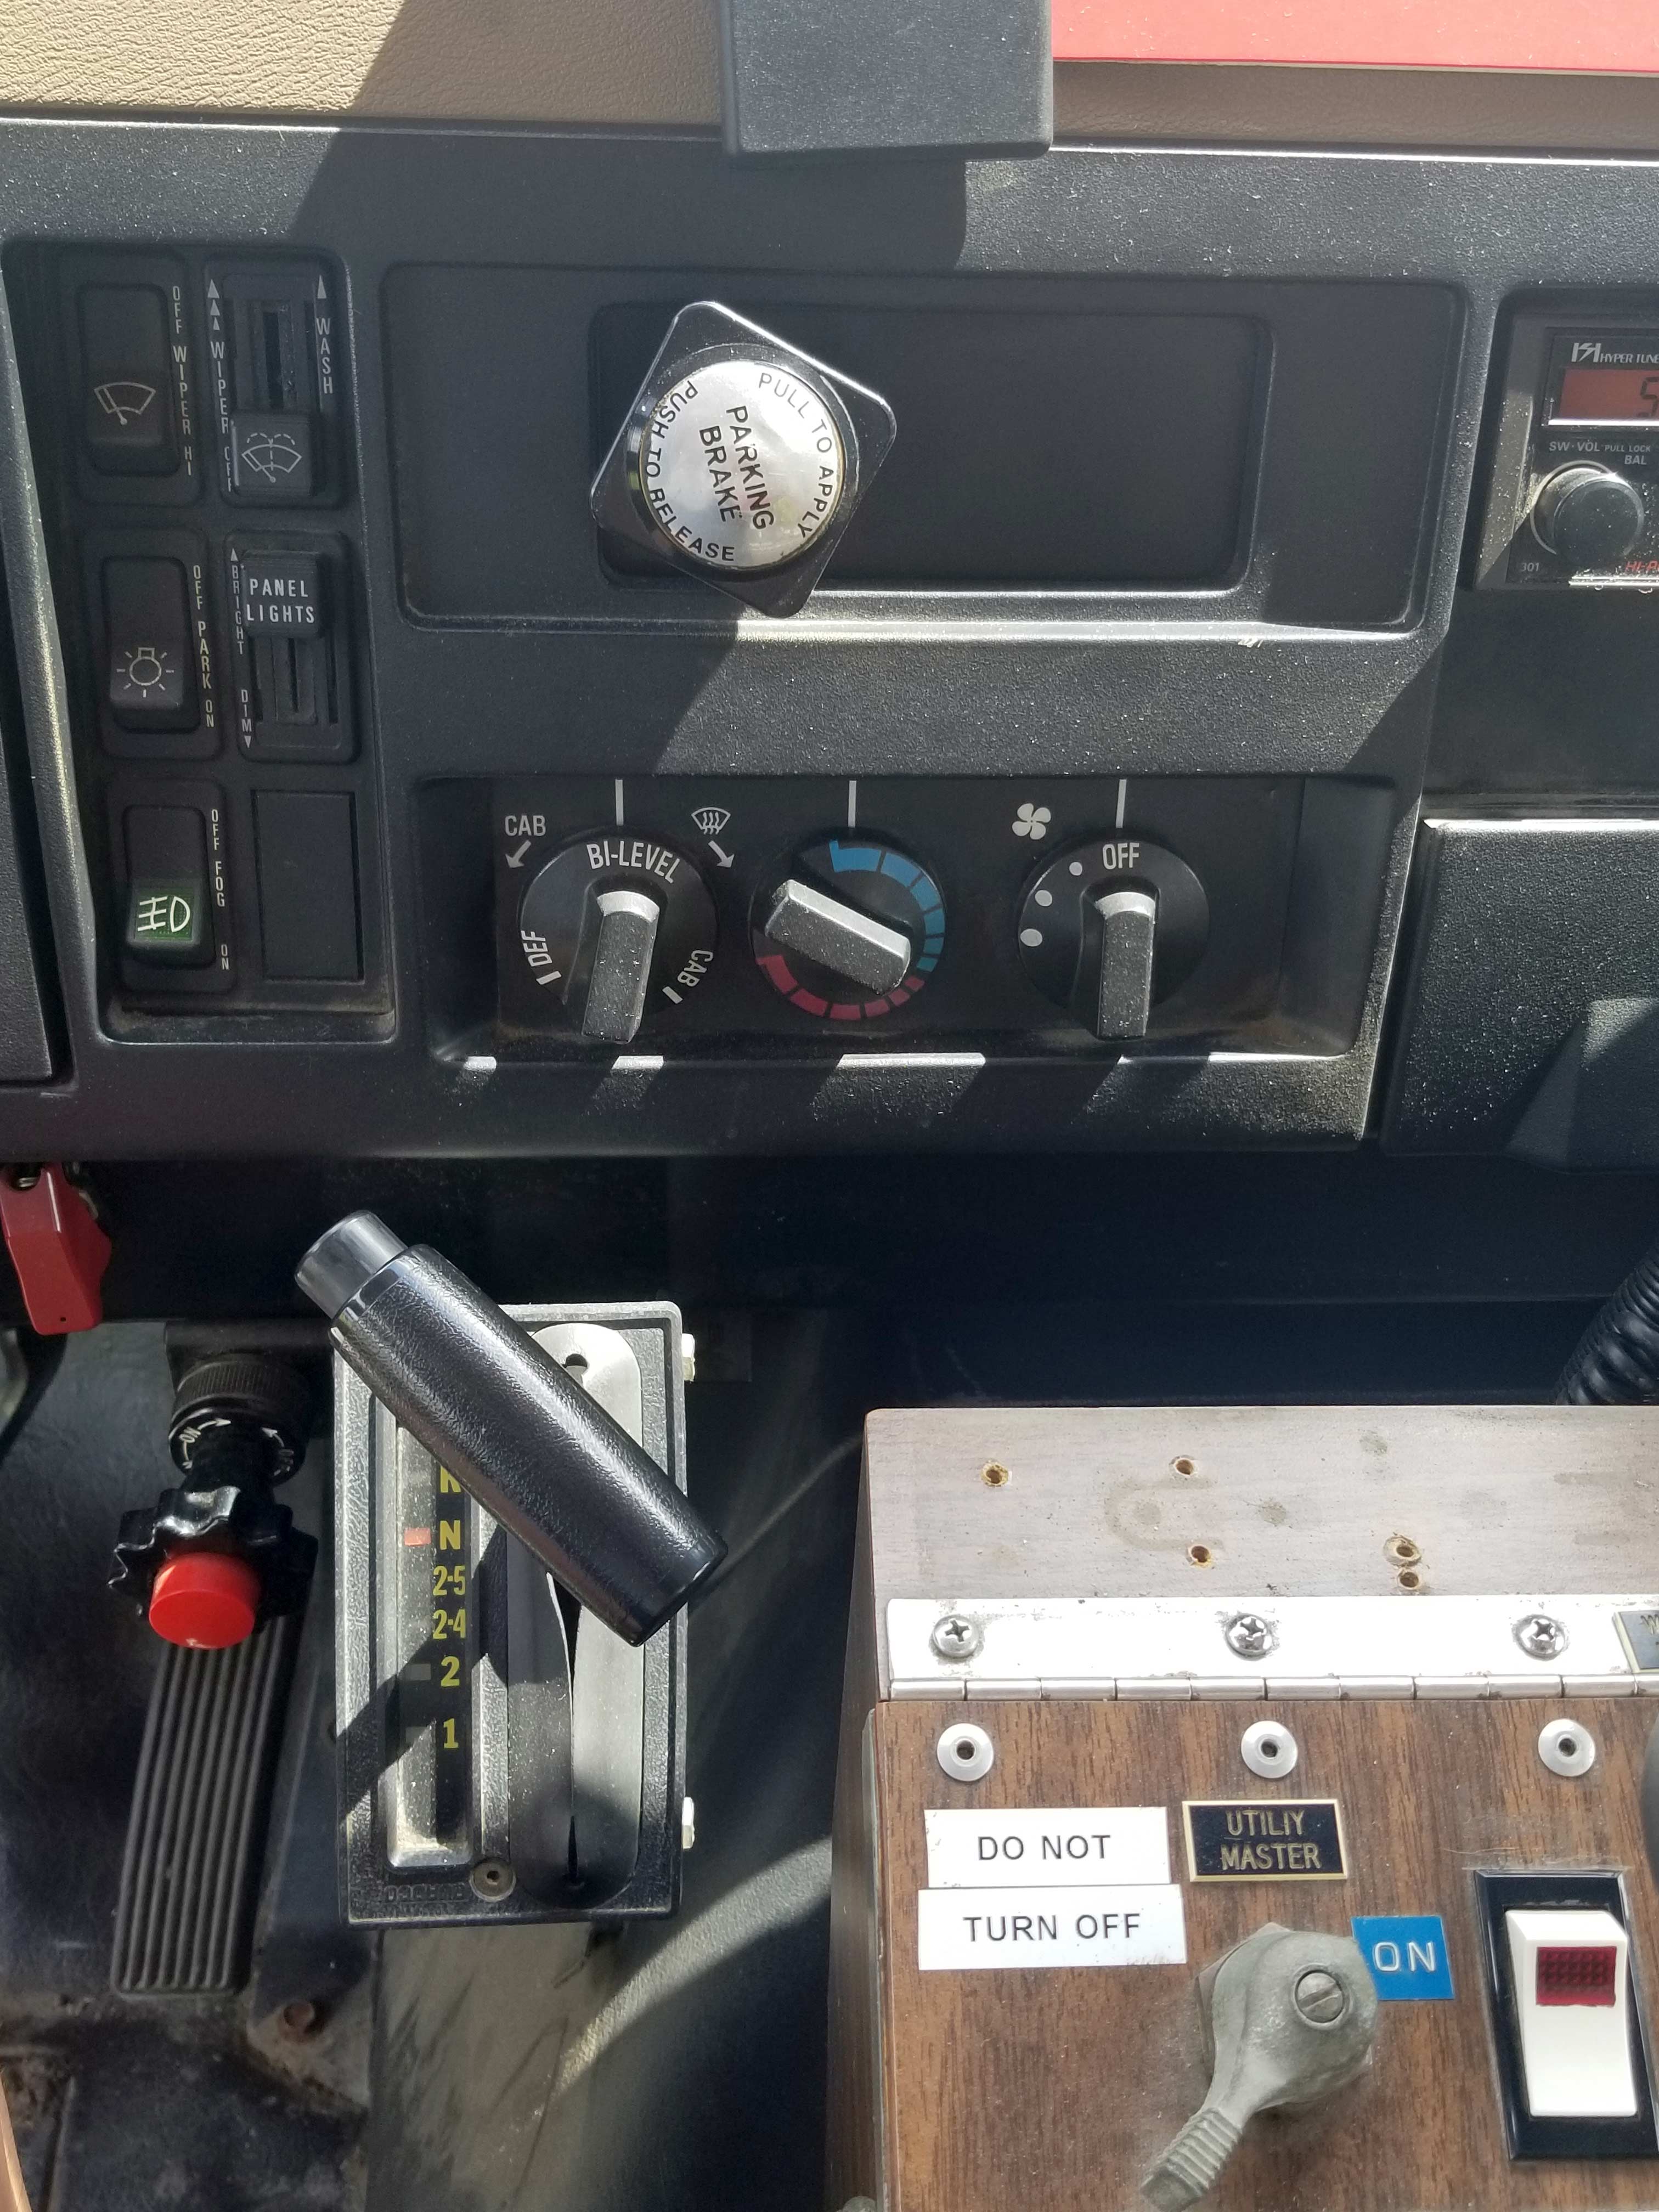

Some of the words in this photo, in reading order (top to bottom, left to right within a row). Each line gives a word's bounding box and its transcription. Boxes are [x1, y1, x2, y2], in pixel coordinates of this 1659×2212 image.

[172, 286, 182, 334] OFF
[316, 318, 332, 393] WASH
[1600, 353, 1633, 363] HYPER
[173, 346, 191, 435] WIPER
[210, 341, 229, 434] WIPER
[758, 373, 811, 419] PULL
[651, 380, 698, 439] PUSH
[812, 419, 832, 453] TO
[185, 447, 192, 476] HI
[646, 448, 662, 478] TO
[699, 426, 741, 522] BRAKE
[726, 405, 775, 529] PARKING
[1624, 455, 1646, 465] BAL
[798, 466, 834, 538] APPLY
[648, 488, 735, 562] RELEASE
[194, 565, 203, 610] OFF
[250, 579, 308, 597] PANEL
[246, 603, 315, 624] LIGHTS
[198, 621, 211, 690] PARK
[232, 565, 245, 654] BRIGHT
[241, 689, 252, 732] DIM
[205, 699, 215, 728] ON
[211, 809, 220, 850] OFF
[505, 815, 546, 837] CAB
[586, 840, 681, 884] BI-LEVEL
[1102, 842, 1140, 870] OFF
[215, 861, 225, 907] FOG
[221, 944, 229, 970] ON
[520, 930, 554, 967] DEF
[676, 949, 714, 988] CAB
[440, 1520, 461, 1550] N
[441, 1656, 460, 1687] 2
[443, 1718, 459, 1750] 1
[978, 1836, 1024, 1861] DO
[1041, 1834, 1111, 1860] NOT
[1221, 1842, 1321, 1870] MASTER
[963, 1915, 1058, 1942] TURN
[1076, 1912, 1141, 1939] OFF
[1373, 1940, 1437, 1972] ON
